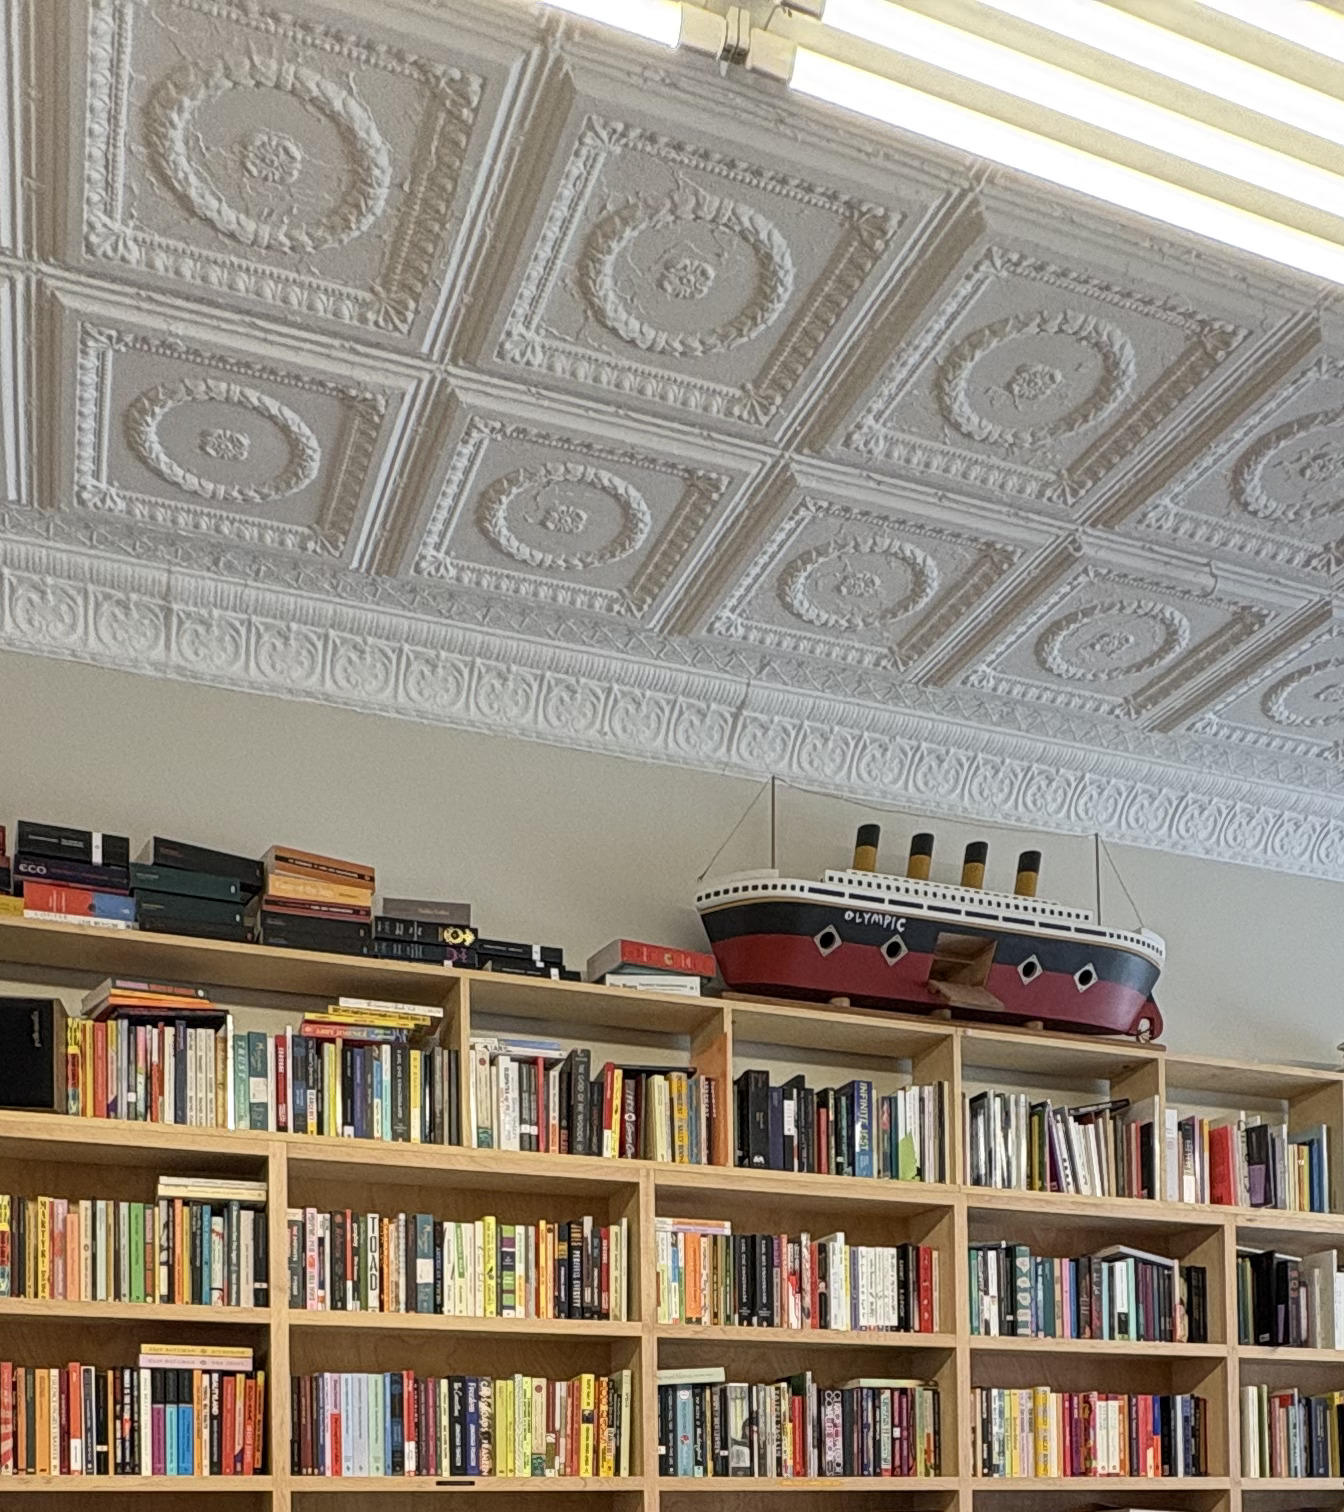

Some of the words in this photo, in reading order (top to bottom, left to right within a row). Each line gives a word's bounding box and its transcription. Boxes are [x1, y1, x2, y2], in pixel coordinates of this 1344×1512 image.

[844, 910, 906, 933] OLYMPIC
[859, 1082, 868, 1121] INFINITE
[369, 1216, 378, 1292] TOAD
